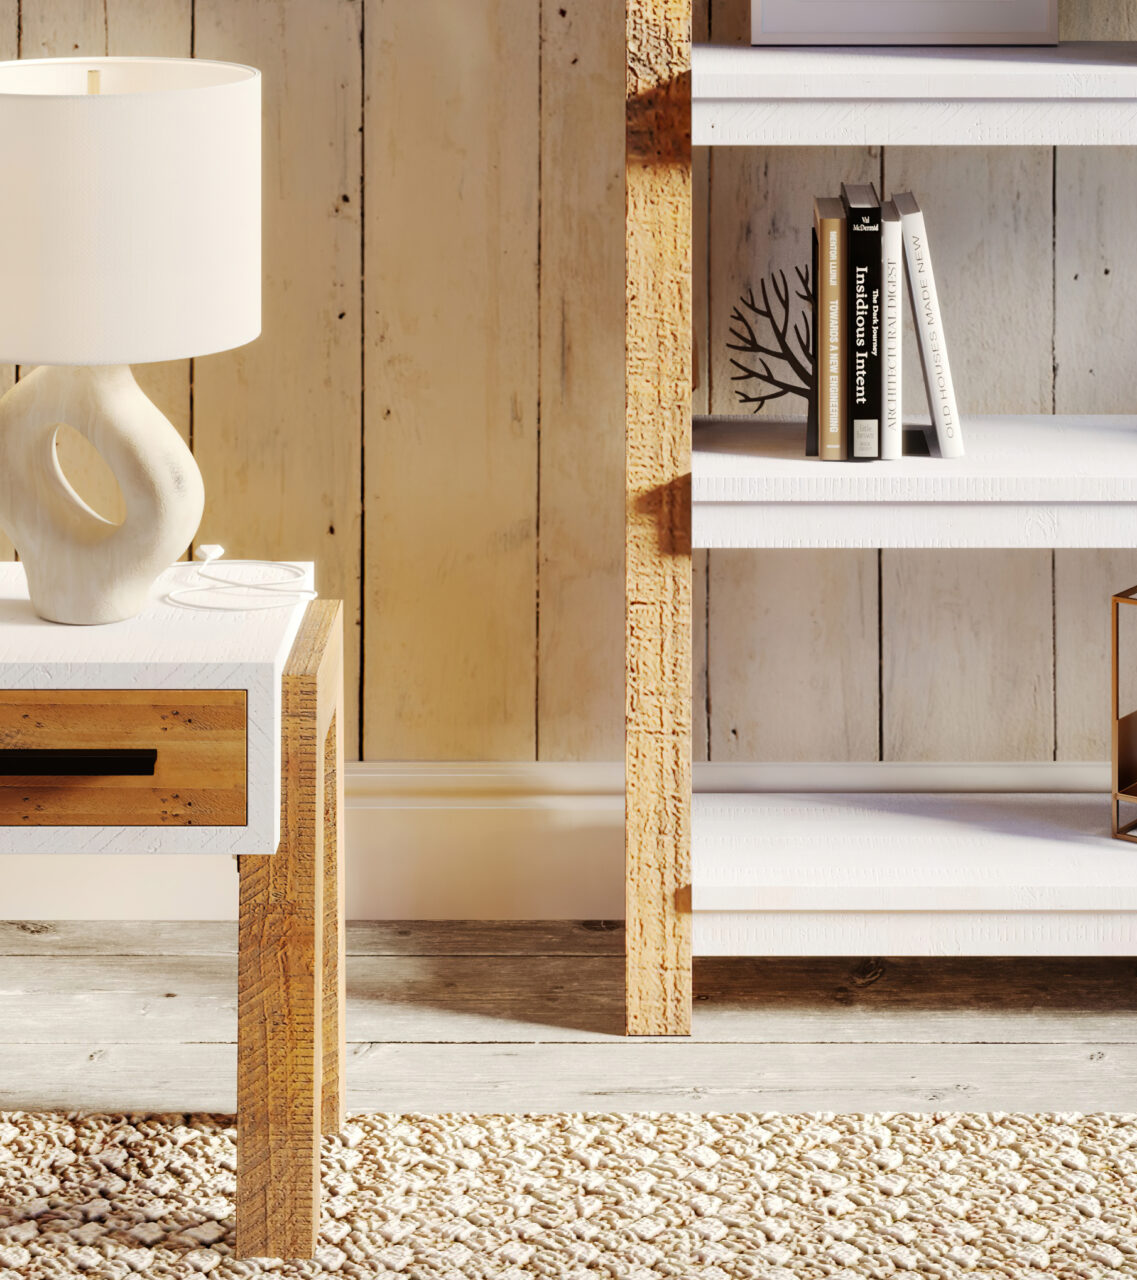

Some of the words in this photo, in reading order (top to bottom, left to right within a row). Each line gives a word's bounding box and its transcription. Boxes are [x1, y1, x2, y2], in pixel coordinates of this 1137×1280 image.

[912, 235, 925, 274] NEW
[855, 266, 869, 347] Insidious
[887, 258, 897, 309] DIGEST
[920, 279, 934, 326] MADE
[829, 299, 839, 343] TOWARDS
[871, 326, 879, 356] Journey
[829, 353, 839, 373] NEW
[855, 351, 869, 404] Intent
[887, 311, 897, 431] ARCHITECTURAL
[929, 330, 947, 400] HOUSES
[829, 375, 839, 433] ENGINEERING
[942, 405, 954, 439] OLD
